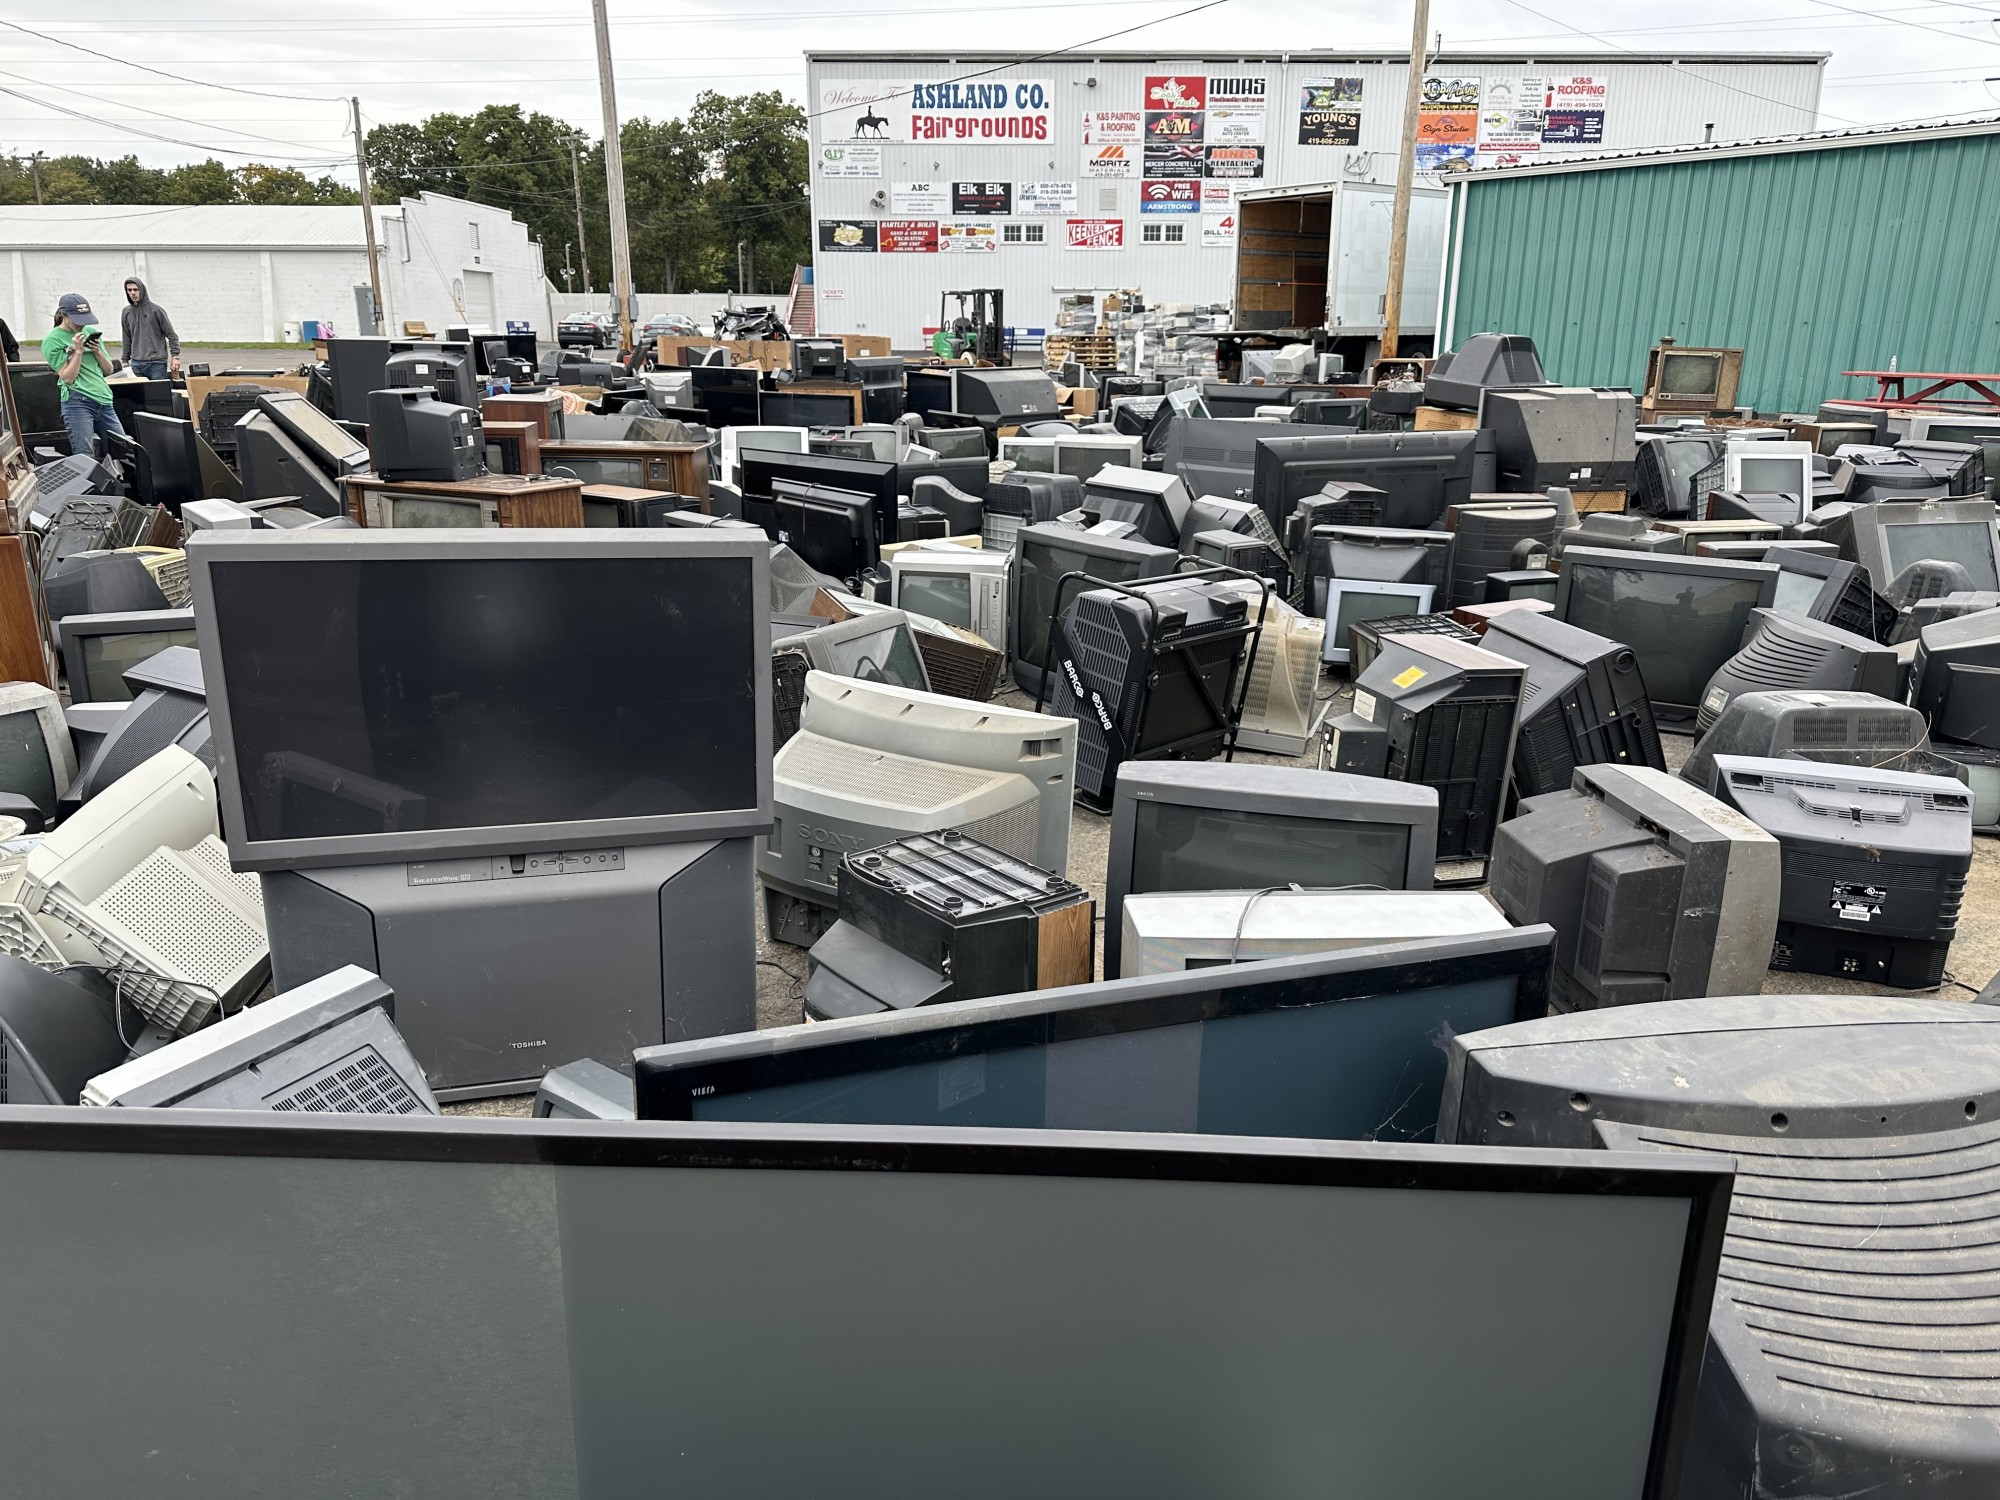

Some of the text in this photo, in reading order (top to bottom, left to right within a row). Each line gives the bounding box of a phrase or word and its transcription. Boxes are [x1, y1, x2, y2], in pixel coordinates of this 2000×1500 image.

[1209, 78, 1266, 95] MOAS
[1572, 76, 1593, 85] K&S
[824, 86, 906, 105] Welcome To
[911, 83, 1049, 109] ASHLAND CO.
[1557, 85, 1606, 95] ROOFING
[1096, 112, 1141, 121] K&S PAINTING
[1304, 112, 1357, 126] YOUNG'S
[911, 115, 1047, 140] Fairgrounds
[1100, 122, 1136, 131] & ROOFING
[1154, 118, 1192, 135] A&M
[1422, 124, 1471, 134] Sign Studio
[1212, 148, 1256, 159] JONES
[911, 183, 930, 191] ABC
[959, 183, 1005, 195] Elk Elk
[1205, 189, 1229, 197] Electric
[1171, 190, 1194, 199] WiFi
[1068, 225, 1105, 243] KEENER
[1086, 228, 1120, 246] FENCE
[1063, 659, 1084, 698] BARCO
[1092, 691, 1113, 731] BARCO
[798, 823, 865, 850] SONY
[511, 1039, 547, 1049] TOSHIBA
